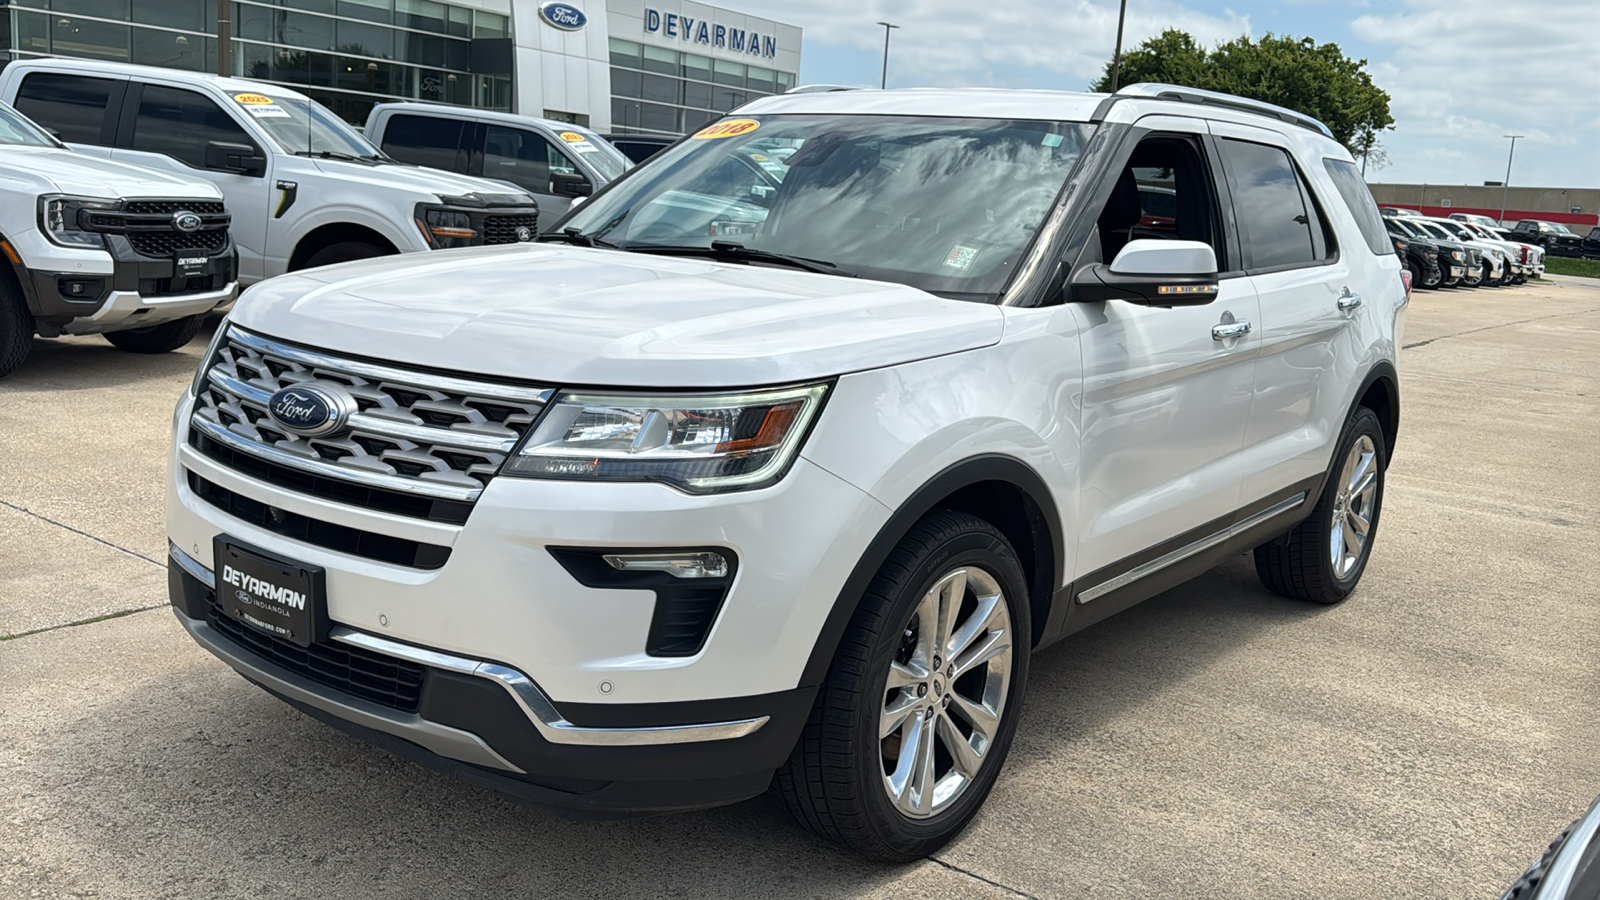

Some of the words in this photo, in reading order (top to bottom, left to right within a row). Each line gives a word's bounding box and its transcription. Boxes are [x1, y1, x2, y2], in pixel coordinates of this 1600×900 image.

[552, 6, 579, 25] Ford
[645, 8, 777, 58] DEYARMAN
[240, 95, 269, 103] 2025
[697, 123, 755, 136] 2018
[275, 392, 316, 422] Ford
[222, 564, 306, 611] DEYARMAN
[253, 599, 291, 618] INDIANOLA
